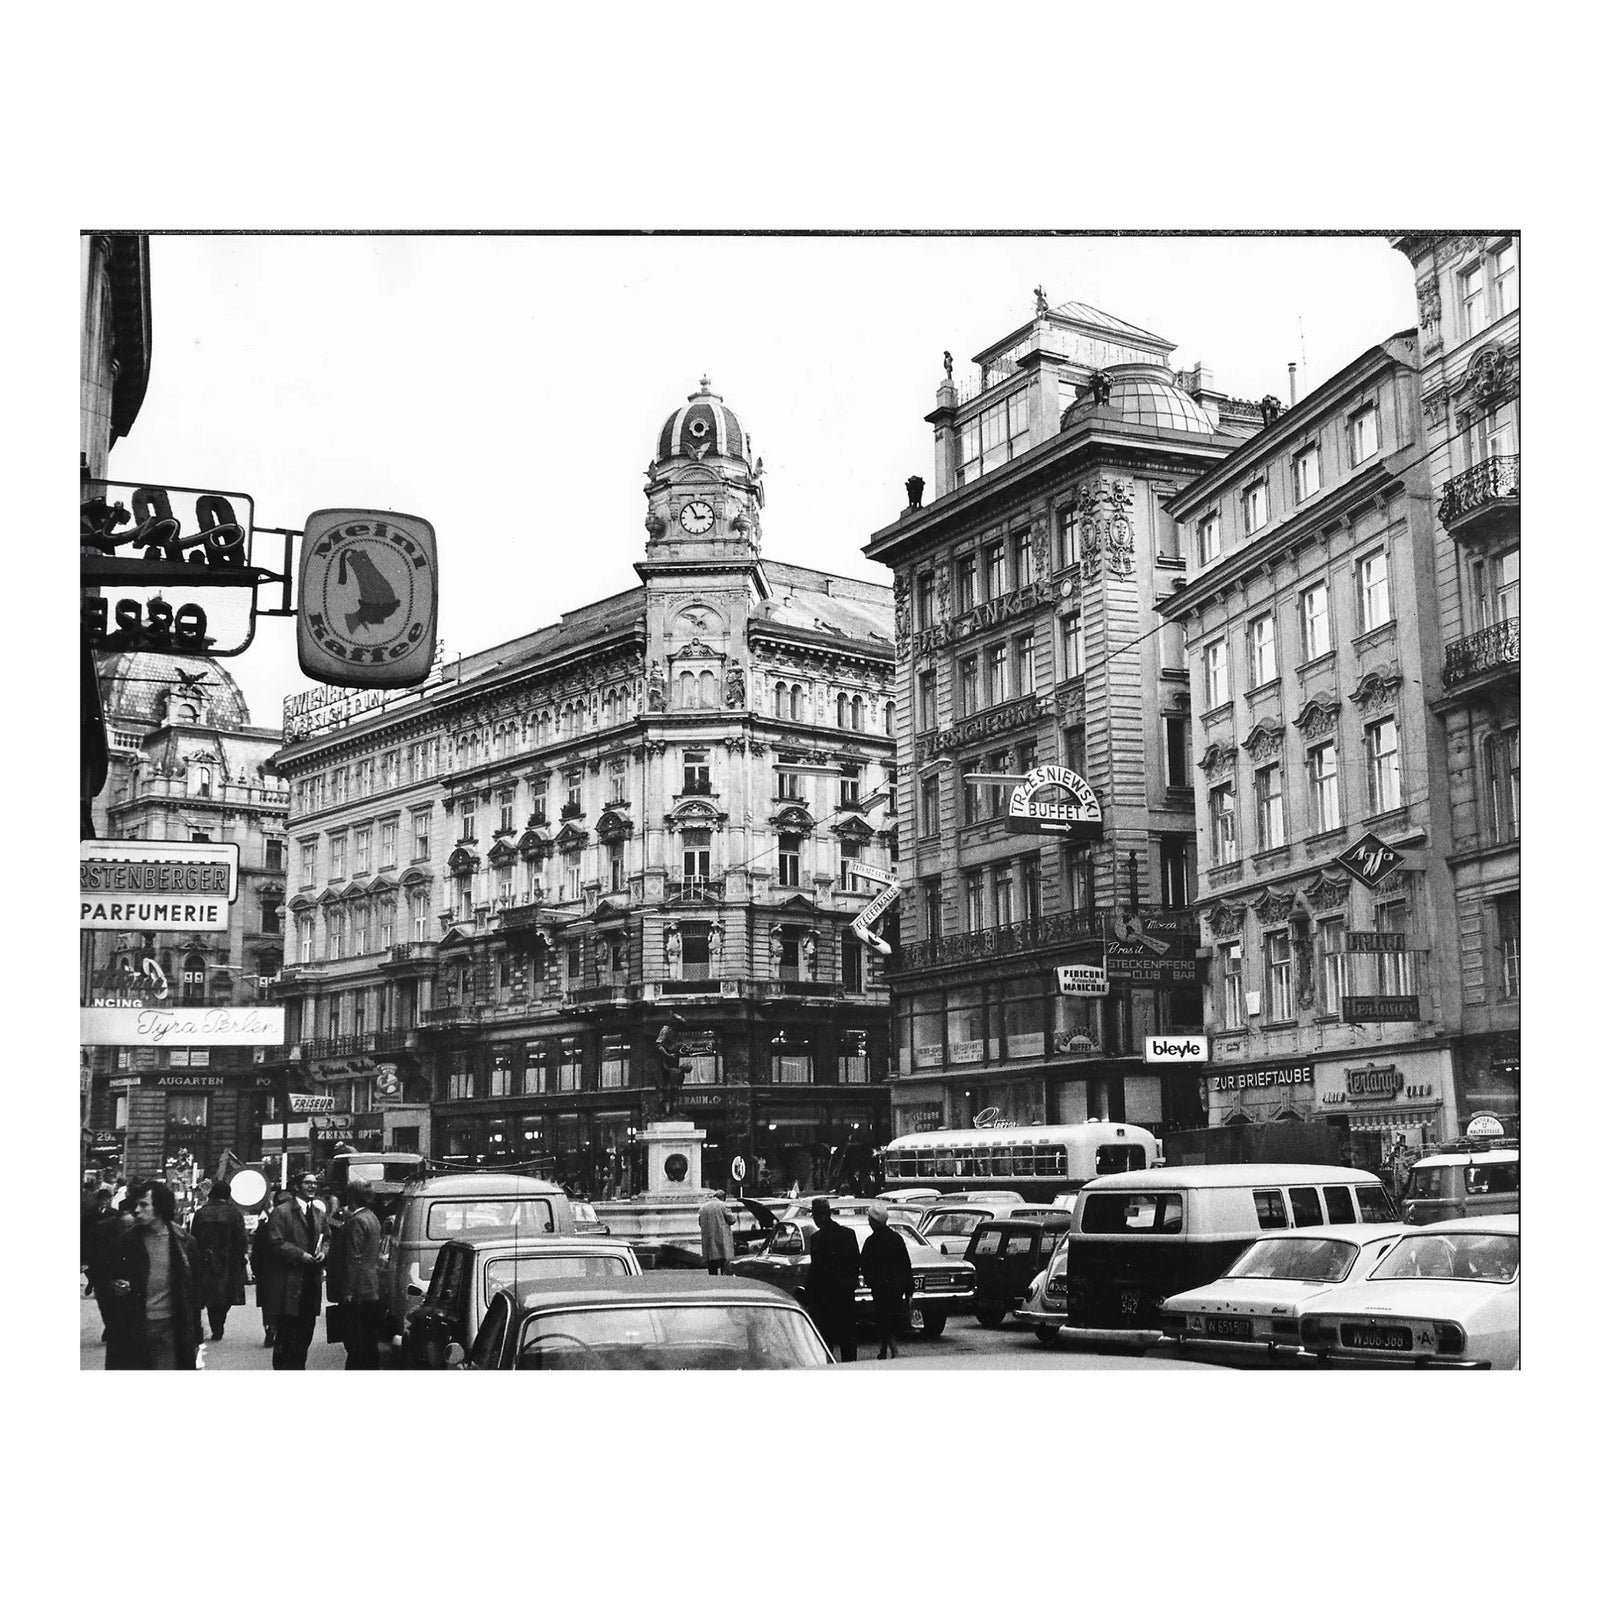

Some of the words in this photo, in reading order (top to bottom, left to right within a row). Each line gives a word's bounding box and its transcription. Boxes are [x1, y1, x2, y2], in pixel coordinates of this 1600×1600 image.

[313, 522, 427, 571] Meinl
[309, 612, 424, 663] Kaffee
[1028, 802, 1081, 820] BUFFET
[1347, 845, 1395, 877] Agfa
[80, 902, 218, 922] PARFUMERIE
[855, 887, 898, 930] FLEDERMAUS
[1145, 918, 1177, 930] Mocca
[1108, 941, 1144, 954] Brasil
[1063, 969, 1104, 979] PEDICURE
[1132, 970, 1160, 980] CLUB
[1173, 970, 1195, 980] BAR
[1063, 982, 1106, 992] MANICURE
[137, 1009, 198, 1042] Tyra
[201, 1008, 279, 1034] Perlen
[1152, 1040, 1200, 1058] bleyle
[157, 1076, 224, 1086] AUGARTEN
[1214, 1076, 1235, 1090] ZUR
[1238, 1067, 1311, 1088] BRIEFTAUBE
[293, 1098, 334, 1109] FRISEUR
[317, 1130, 354, 1140] ZEISS
[1420, 1331, 1432, 1345] A
